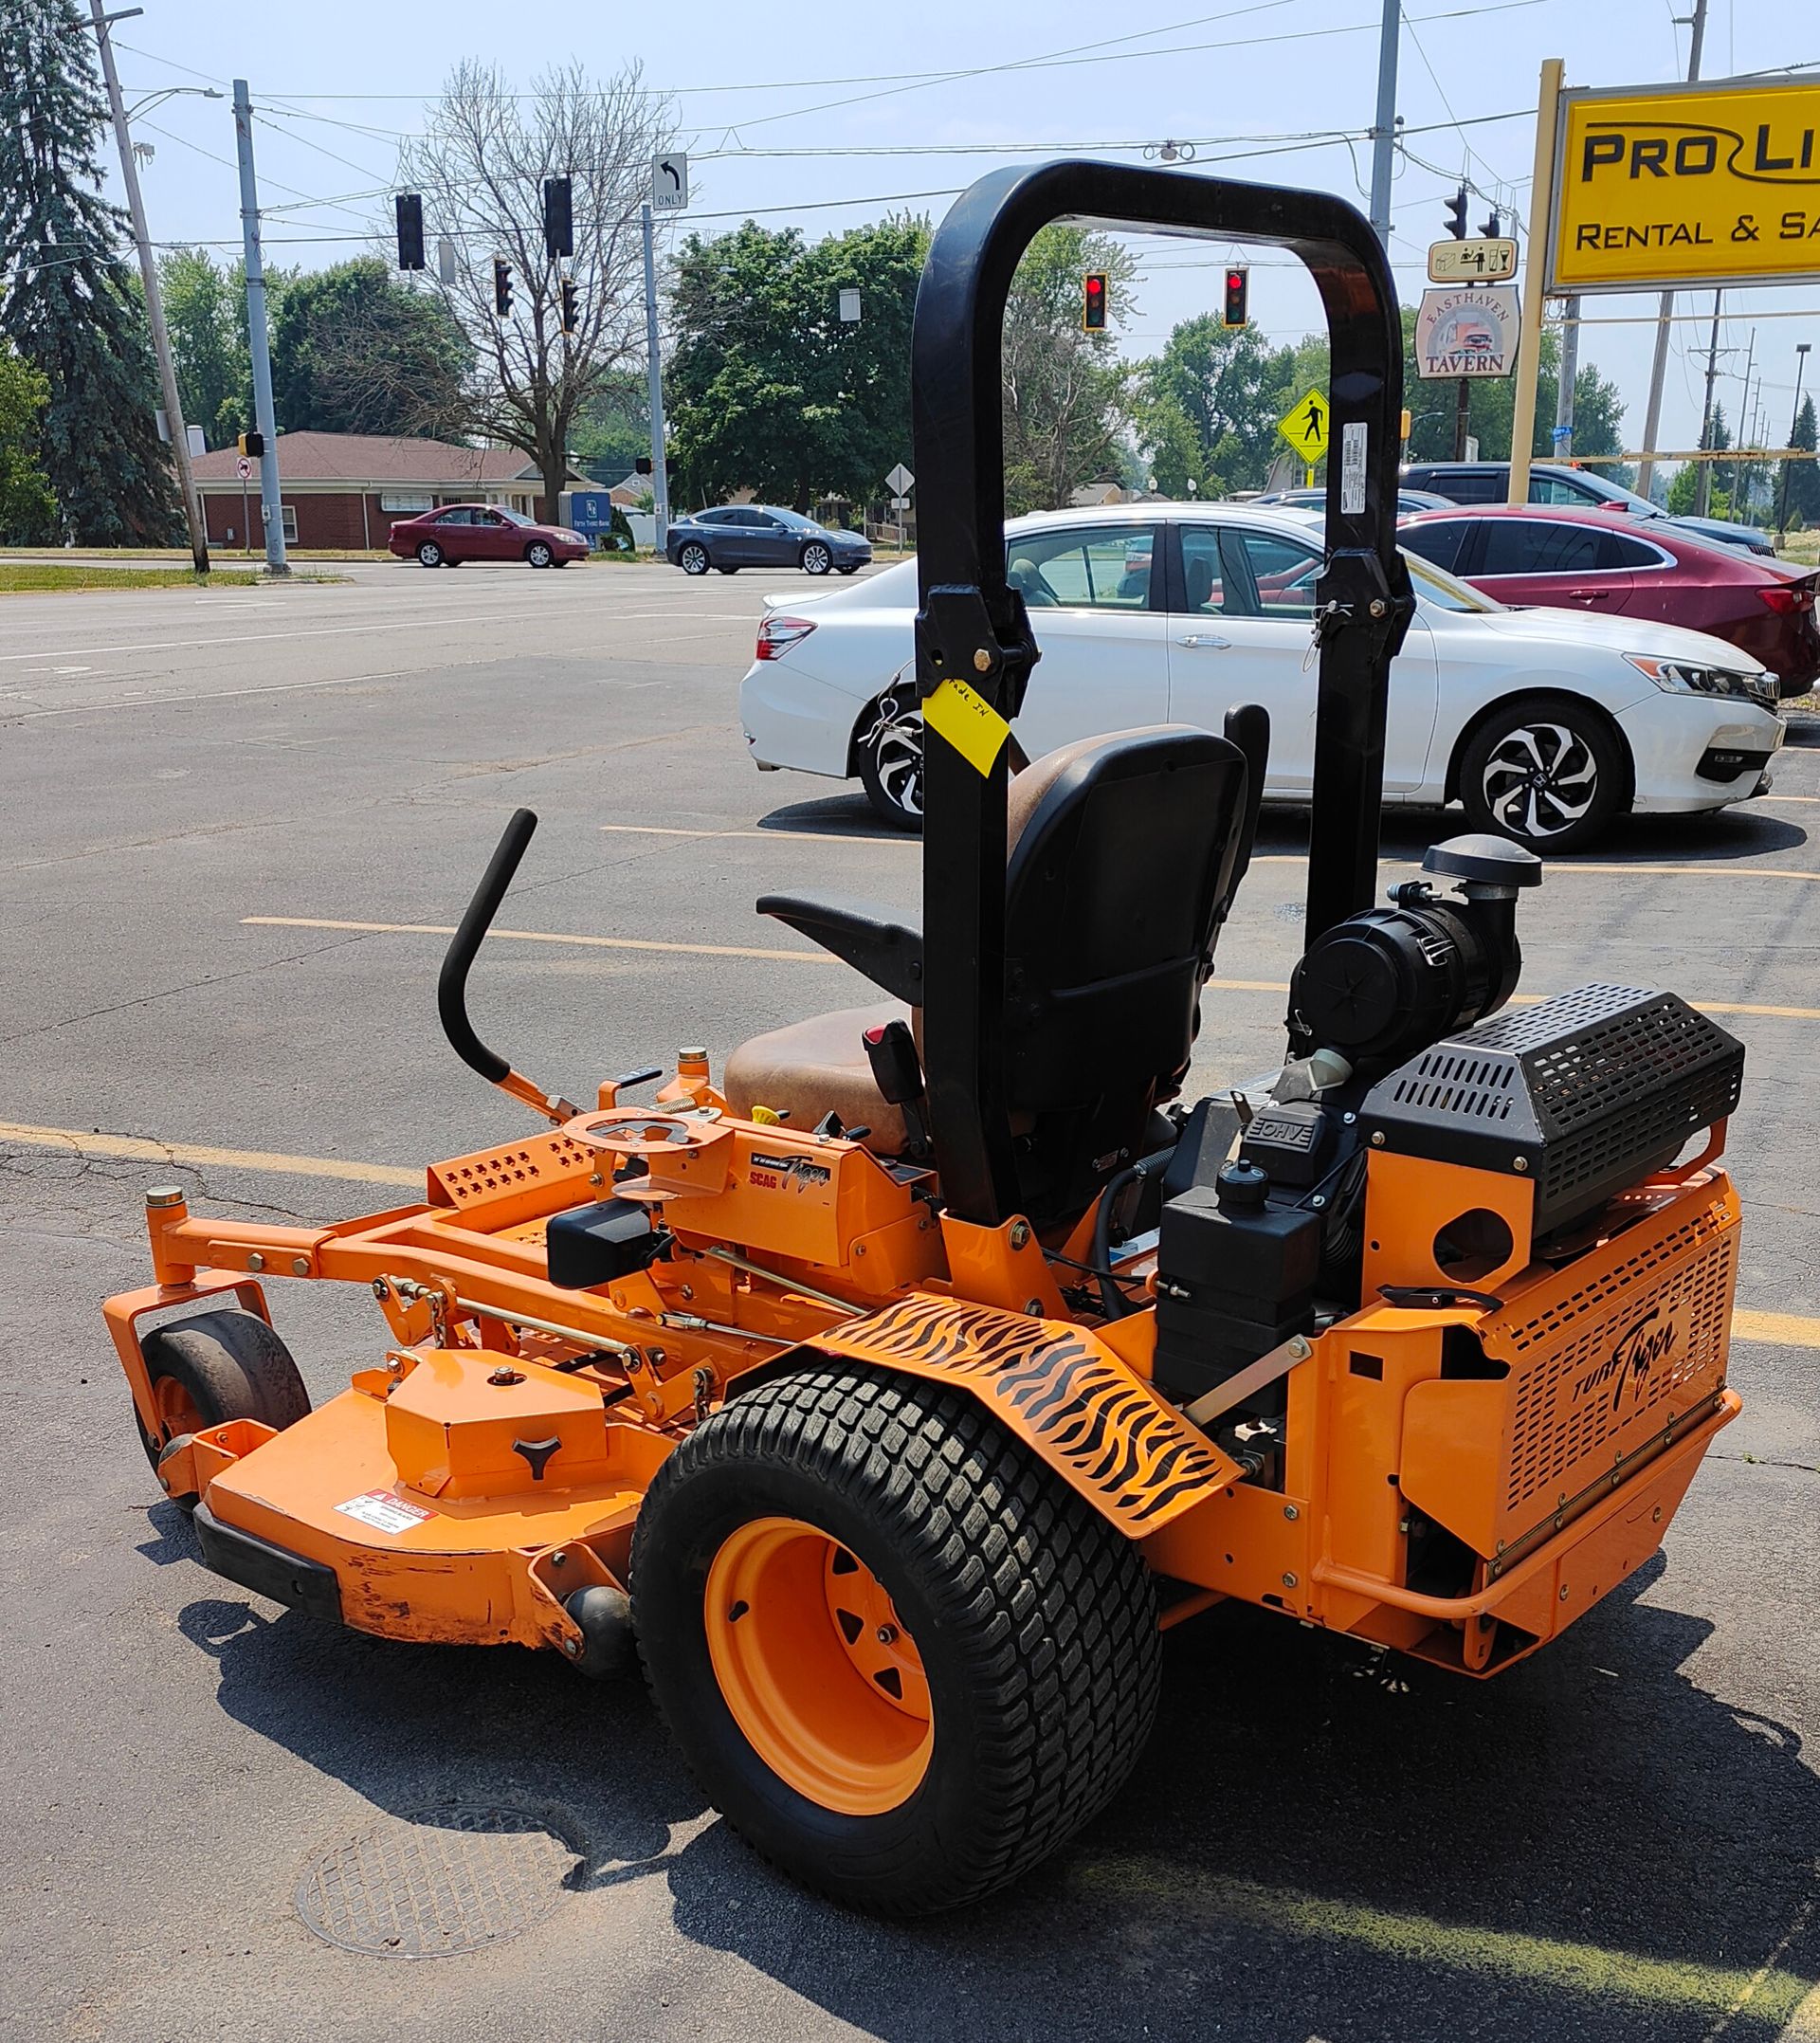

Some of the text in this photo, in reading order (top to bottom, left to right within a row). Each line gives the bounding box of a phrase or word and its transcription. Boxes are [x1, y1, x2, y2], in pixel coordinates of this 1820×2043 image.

[1582, 134, 1718, 182] PRO
[658, 193, 682, 206] ONLY
[1576, 222, 1714, 250] RENTAL
[1731, 214, 1759, 242] &
[1427, 292, 1509, 324] EASTHAVEN
[1426, 354, 1504, 373] TAVERN
[1262, 1123, 1303, 1140] OHV
[750, 1171, 777, 1190] SCAG
[385, 1498, 431, 1518] DANGER
